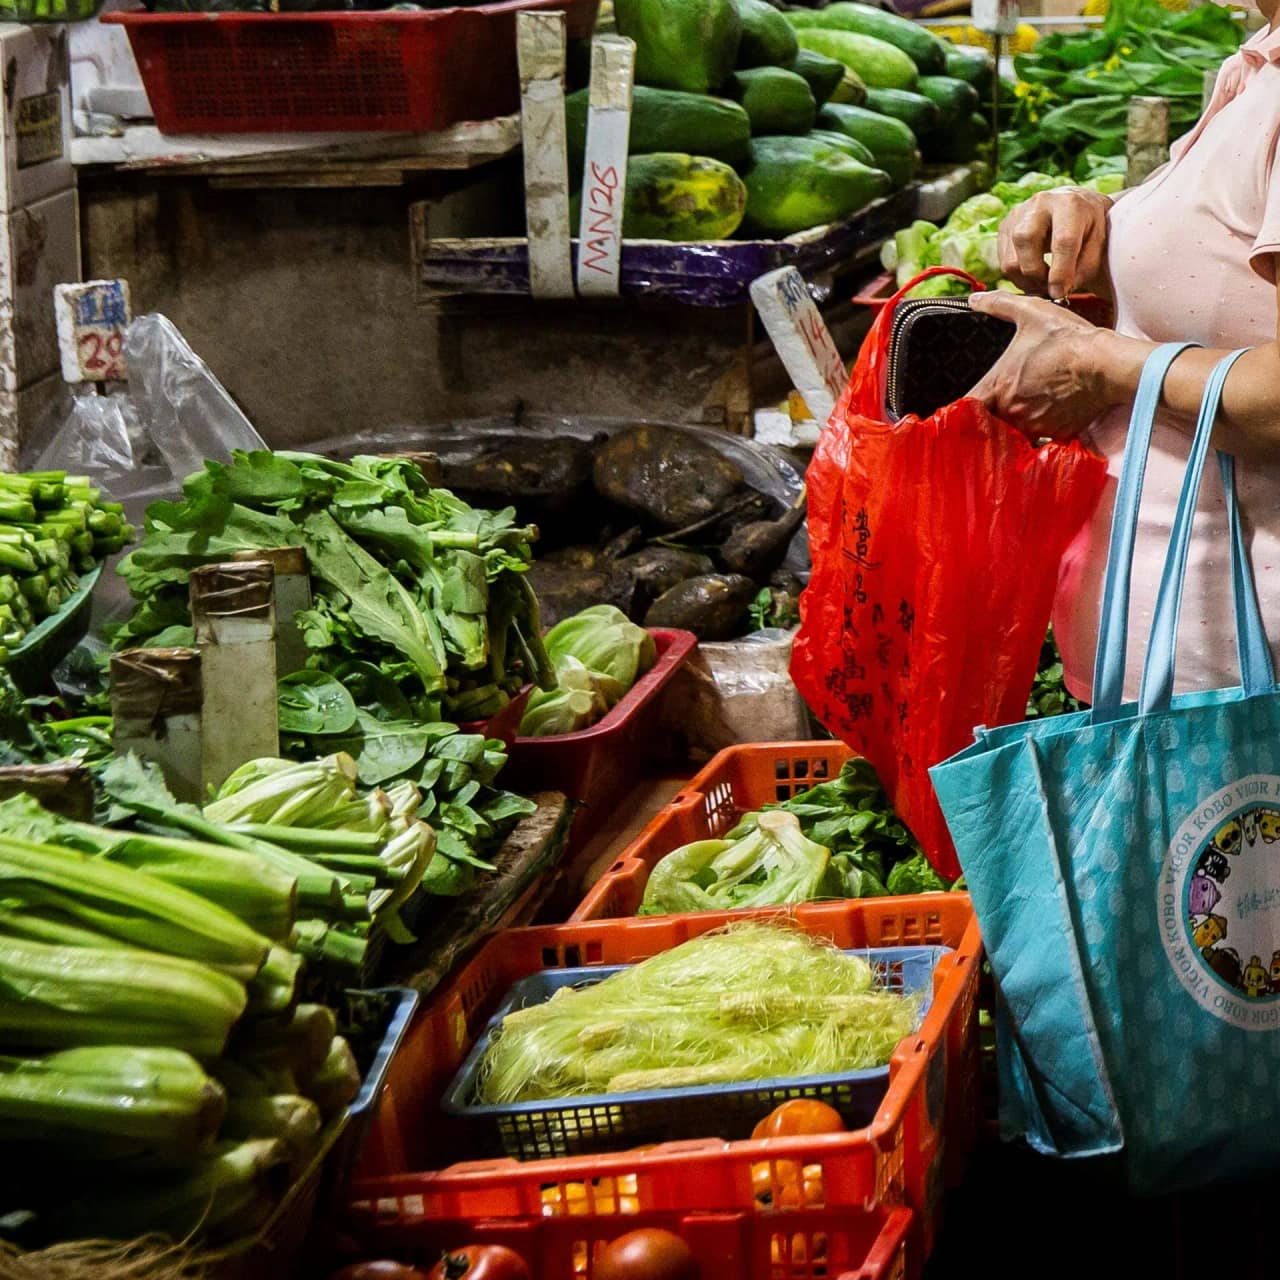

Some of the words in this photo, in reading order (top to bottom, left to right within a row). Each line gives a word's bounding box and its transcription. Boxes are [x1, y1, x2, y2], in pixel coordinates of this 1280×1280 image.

[1192, 792, 1234, 830] KOBO
[1162, 893, 1178, 944] KOBO
[1173, 948, 1211, 1000] VIGOR
